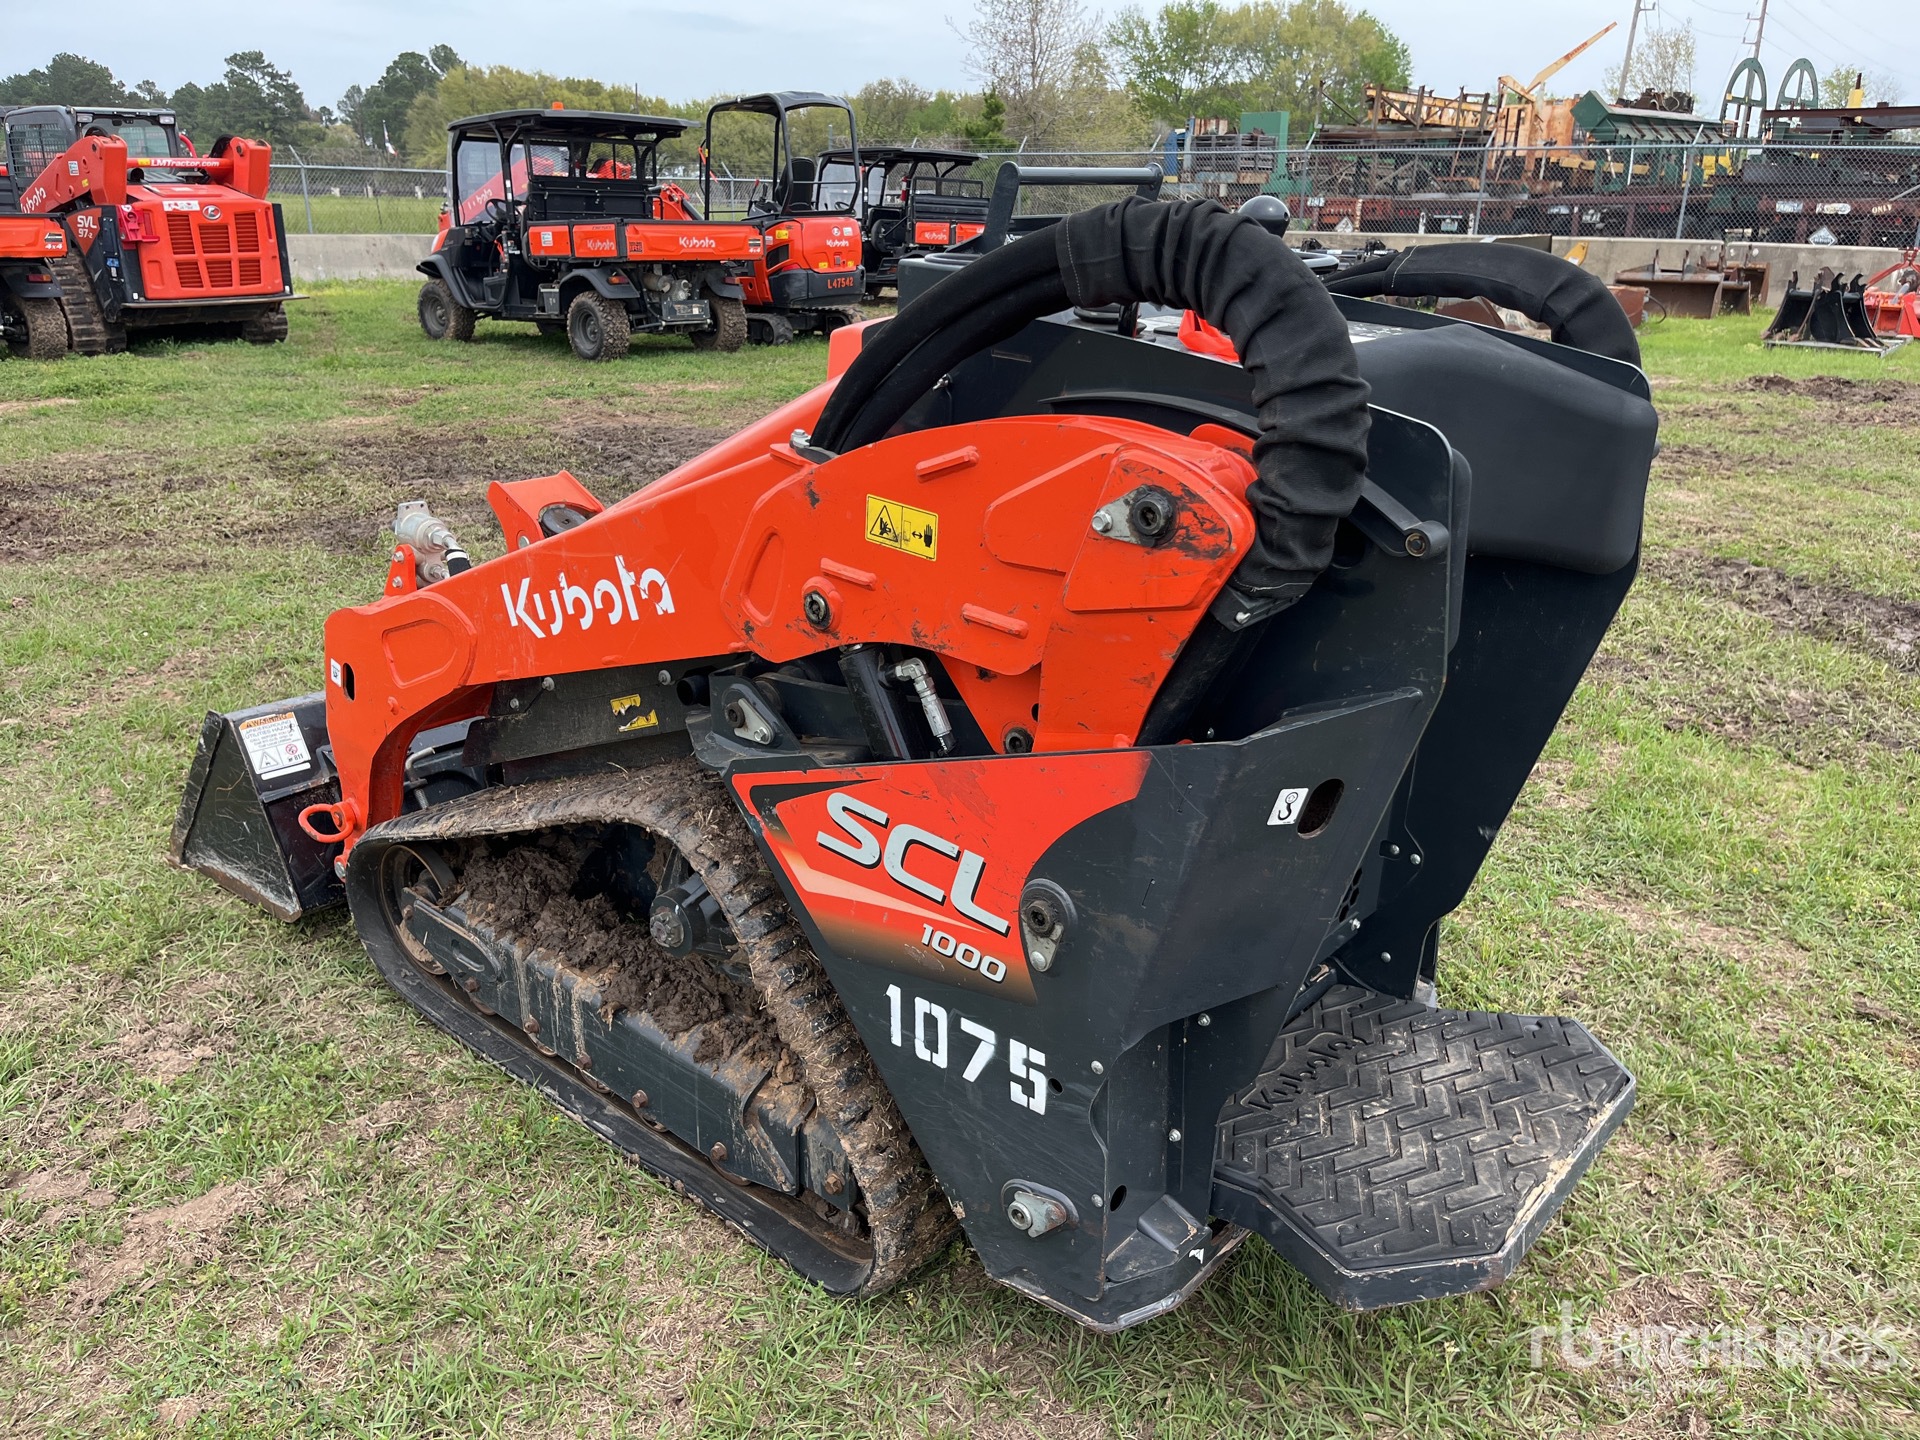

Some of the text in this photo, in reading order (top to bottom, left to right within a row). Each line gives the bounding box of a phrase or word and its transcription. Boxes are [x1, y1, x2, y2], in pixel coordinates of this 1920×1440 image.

[151, 159, 220, 167] LMTractor.com
[77, 215, 97, 229] SVL
[587, 239, 615, 251] Kubota
[679, 236, 716, 248] Kubota
[826, 239, 849, 248] Kubota
[827, 277, 854, 289] L47542
[501, 555, 675, 638] Kubota
[252, 712, 287, 727] WARNING
[816, 792, 1011, 938] SCL
[920, 923, 1007, 982] 1000
[885, 983, 1048, 1116] 1075
